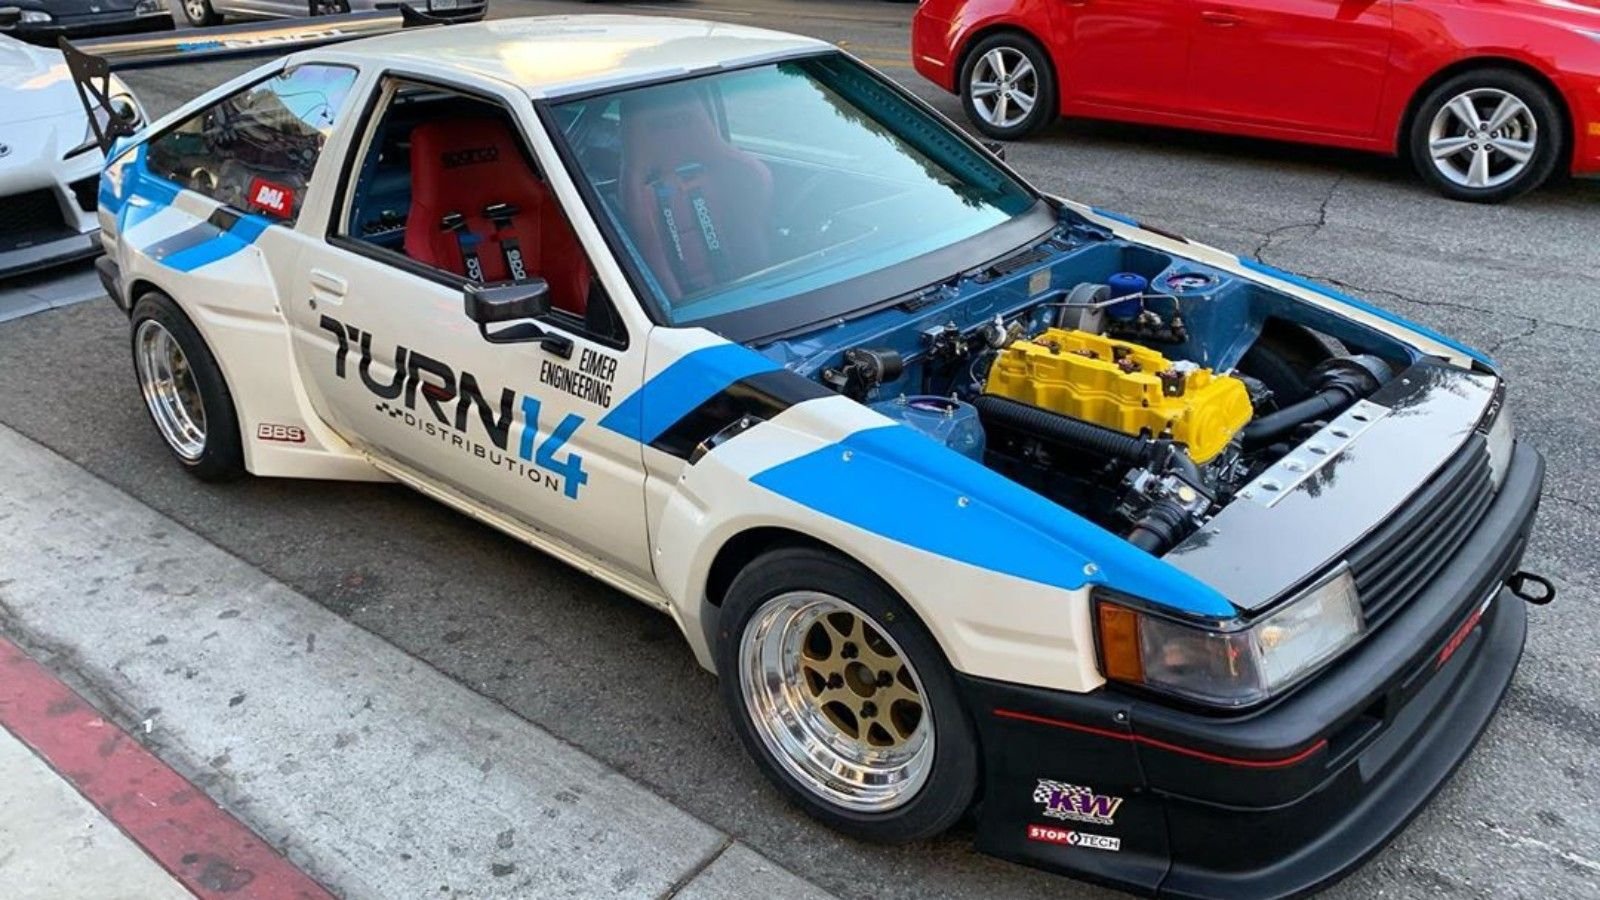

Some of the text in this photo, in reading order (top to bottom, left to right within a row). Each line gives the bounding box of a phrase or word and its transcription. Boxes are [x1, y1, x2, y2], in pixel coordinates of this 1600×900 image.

[540, 359, 612, 409] ENGINEERING
[579, 348, 618, 382] EIMER
[257, 422, 306, 443] BBS
[404, 412, 559, 492] DISTRIBUTION
